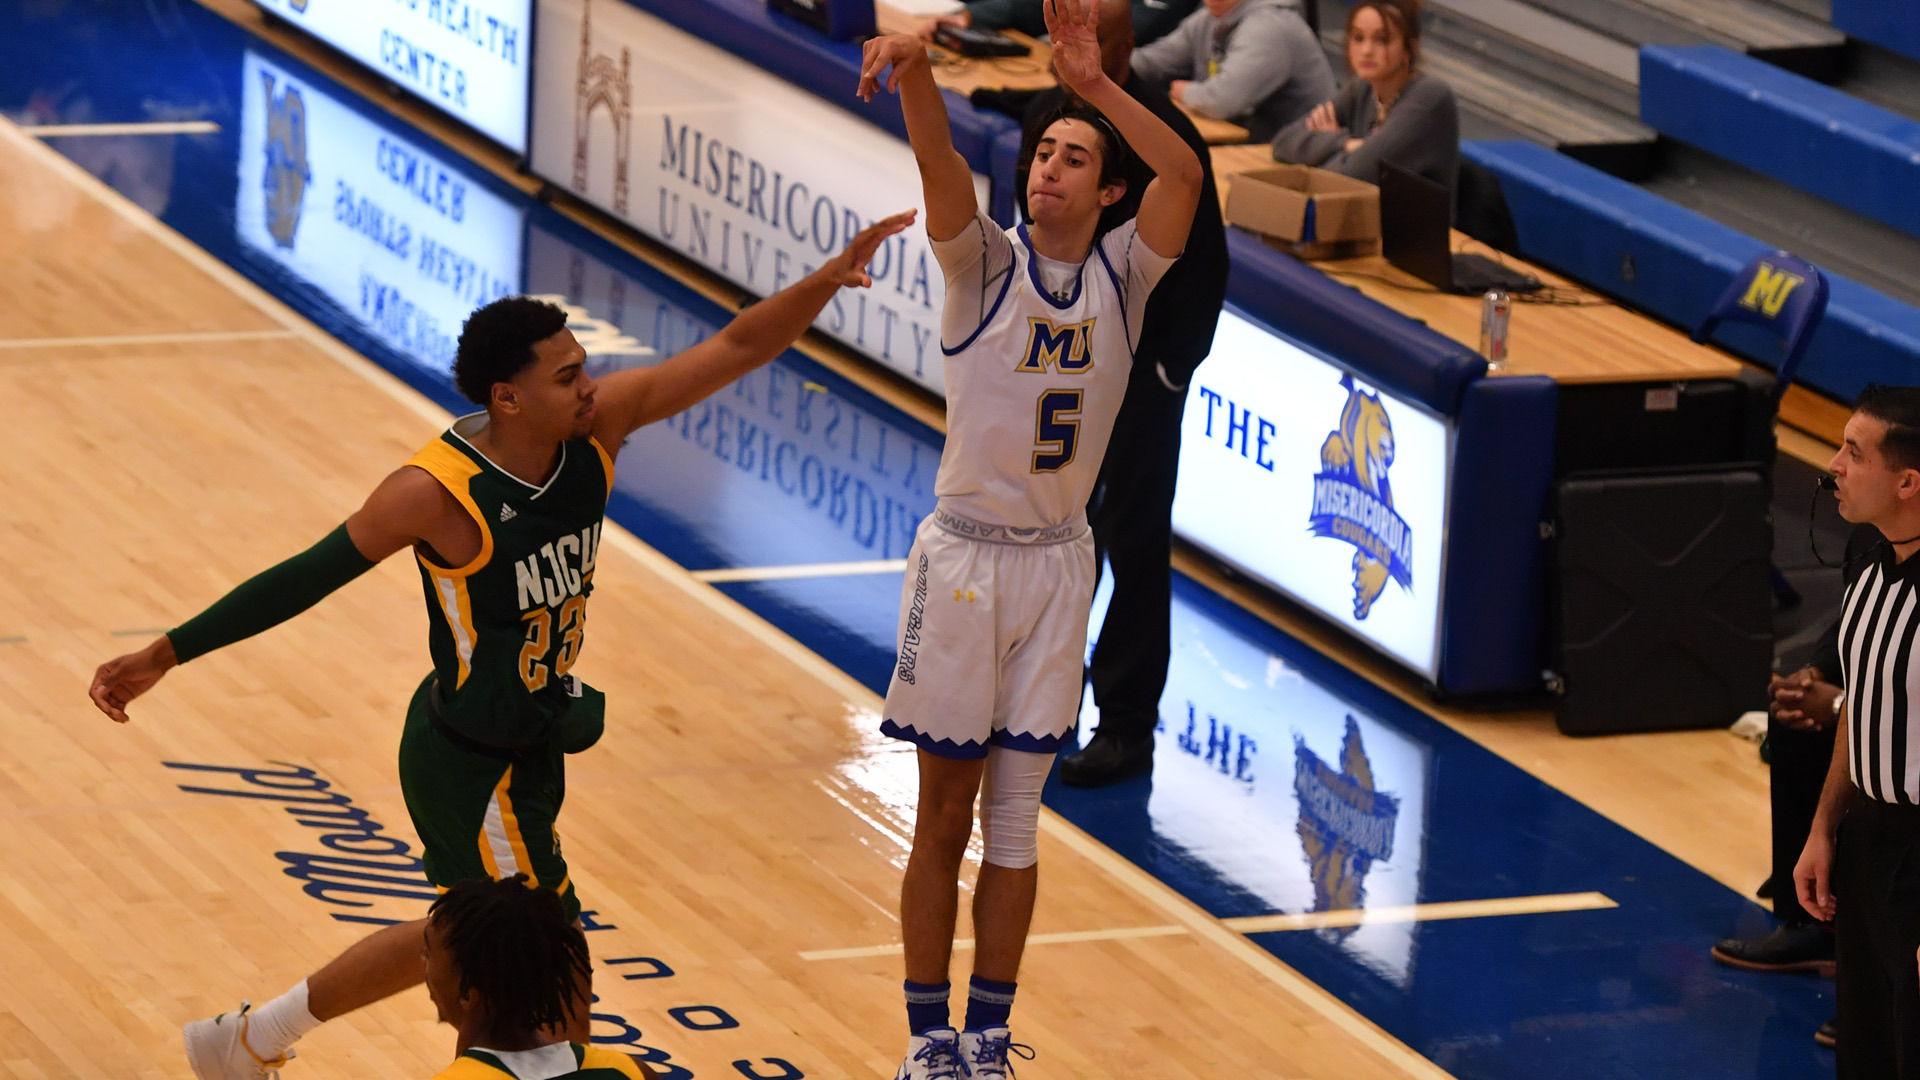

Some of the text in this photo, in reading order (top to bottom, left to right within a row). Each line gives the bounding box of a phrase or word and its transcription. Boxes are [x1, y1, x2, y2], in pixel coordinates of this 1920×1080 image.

[380, 28, 468, 108] CENTER
[659, 115, 931, 307] MISERICORDIA
[1738, 262, 1804, 317] MU
[1015, 316, 1097, 374] MU
[1030, 388, 1084, 474] 5
[1200, 385, 1277, 472] THE
[515, 522, 600, 610] NJCU
[1312, 478, 1411, 574] MISERICORDIA
[1332, 516, 1391, 567] COUGARS
[518, 594, 588, 693] 23
[898, 551, 929, 685] COUGARS
